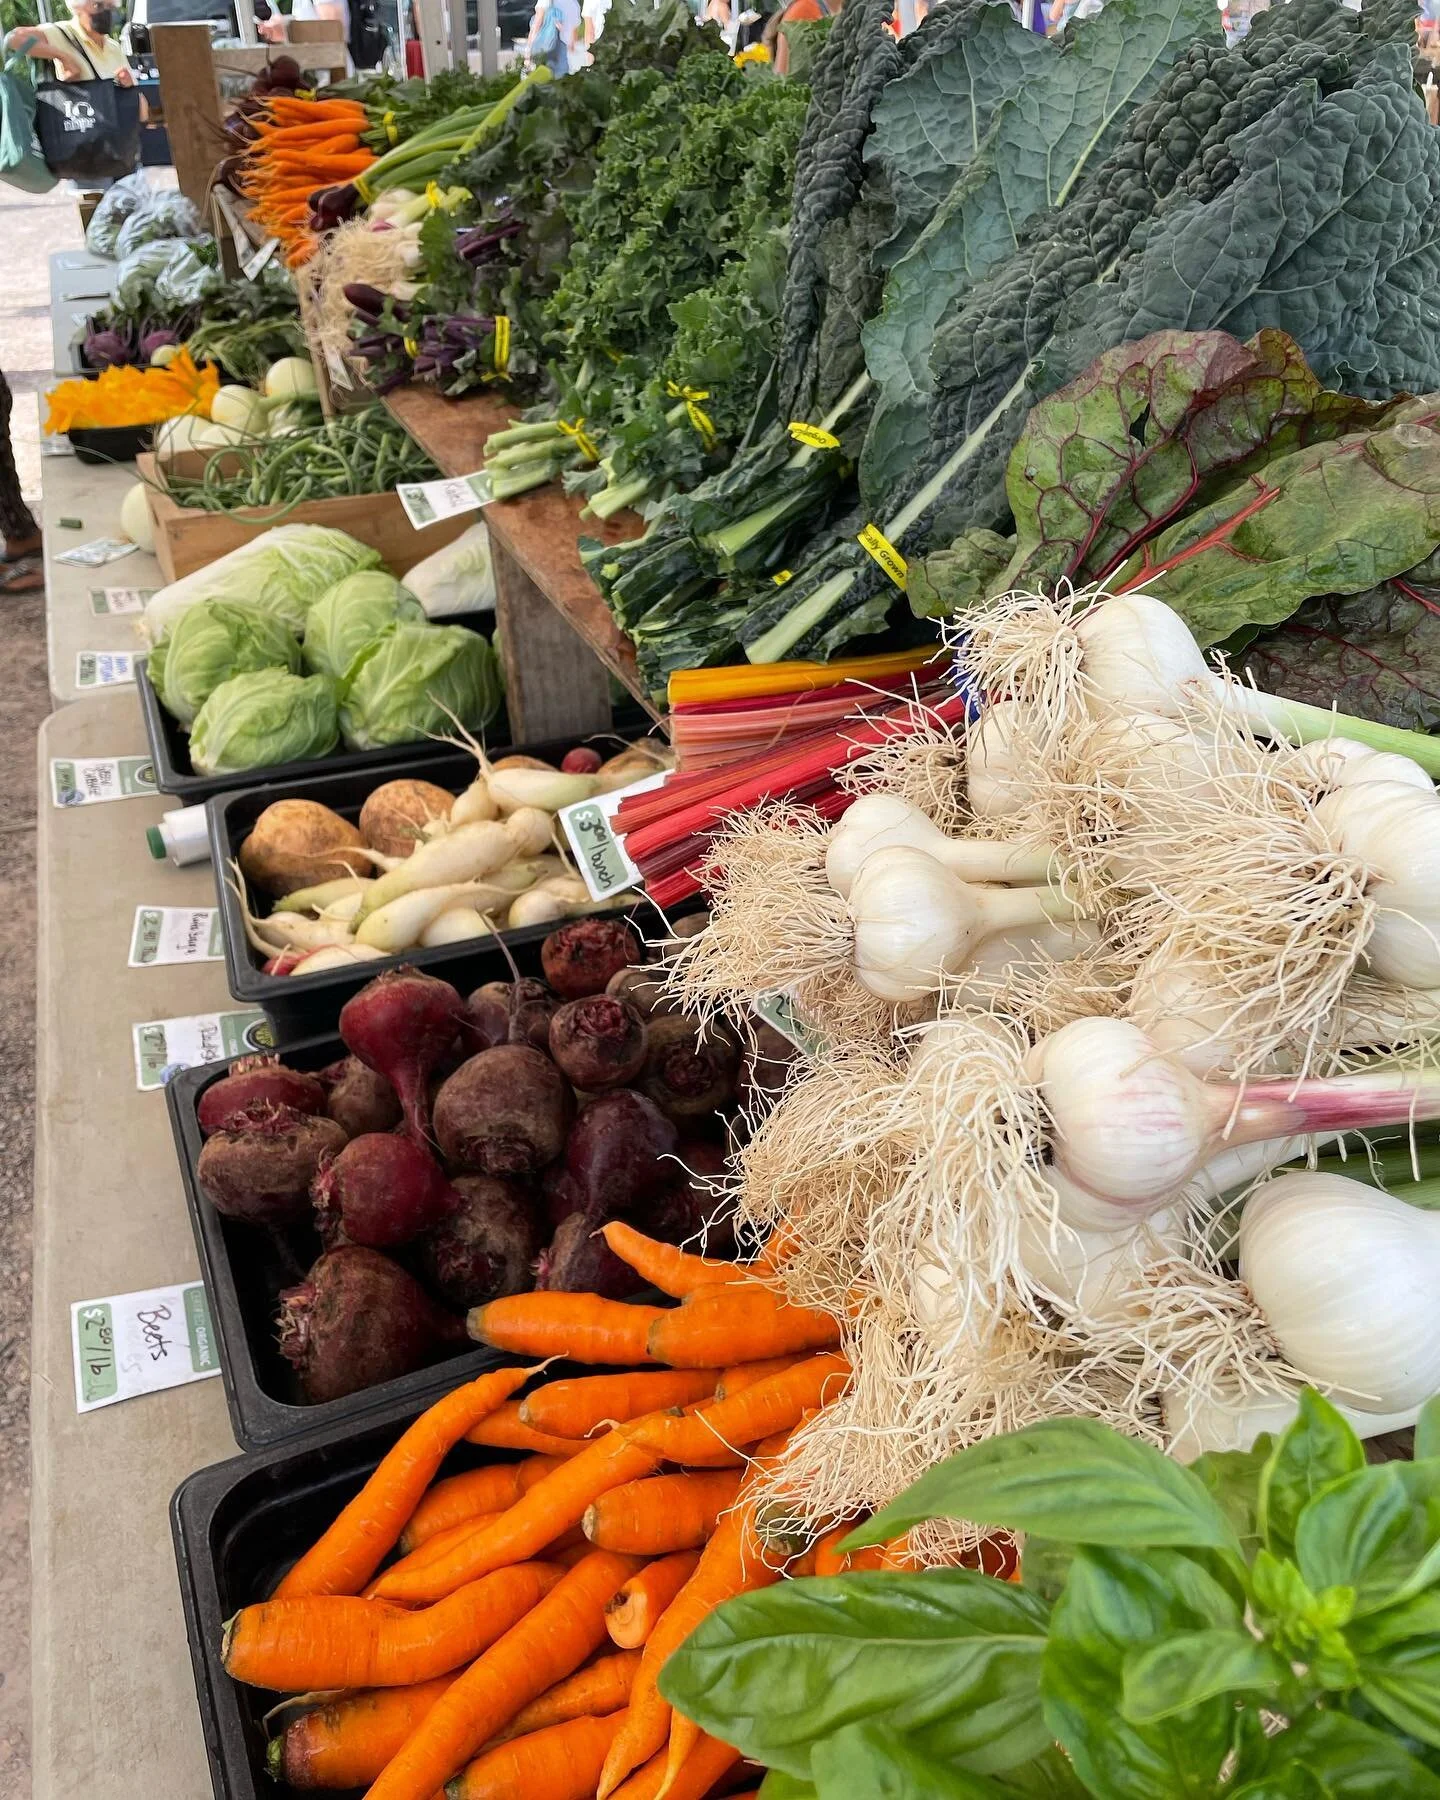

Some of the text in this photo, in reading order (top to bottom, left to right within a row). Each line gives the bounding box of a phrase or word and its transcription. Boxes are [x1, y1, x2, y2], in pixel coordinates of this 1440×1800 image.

[879, 550, 905, 579] Grown
[137, 1304, 172, 1361] Beets
[195, 1326, 211, 1367] ORGANIC
